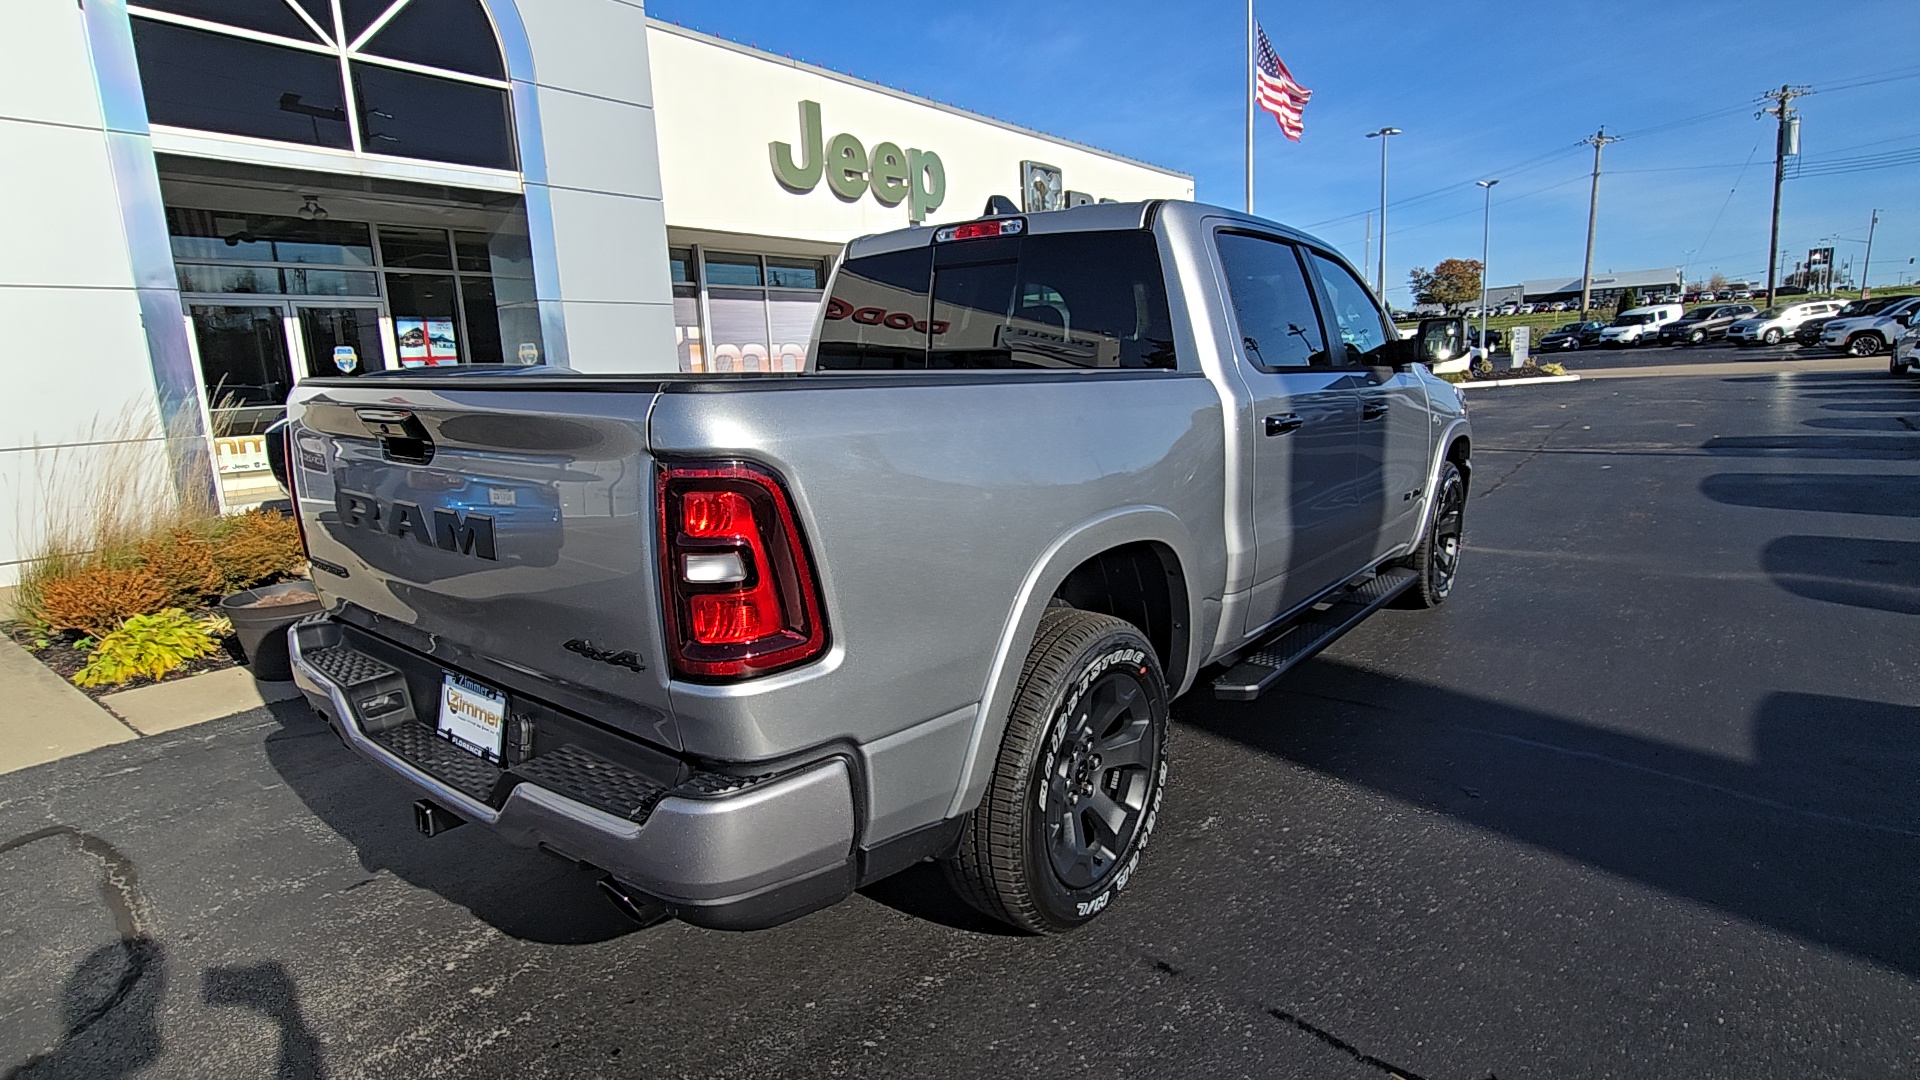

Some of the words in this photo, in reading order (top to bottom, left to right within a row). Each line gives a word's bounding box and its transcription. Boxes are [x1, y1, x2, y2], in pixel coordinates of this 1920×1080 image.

[768, 100, 946, 221] Jeep
[339, 488, 499, 561] RAM
[458, 674, 490, 697] Zimmer
[449, 691, 501, 728] Zimmer
[452, 737, 482, 757] FLORENCE
[1038, 648, 1145, 812] BRIDGESTONE
[1076, 890, 1111, 917] H/L
